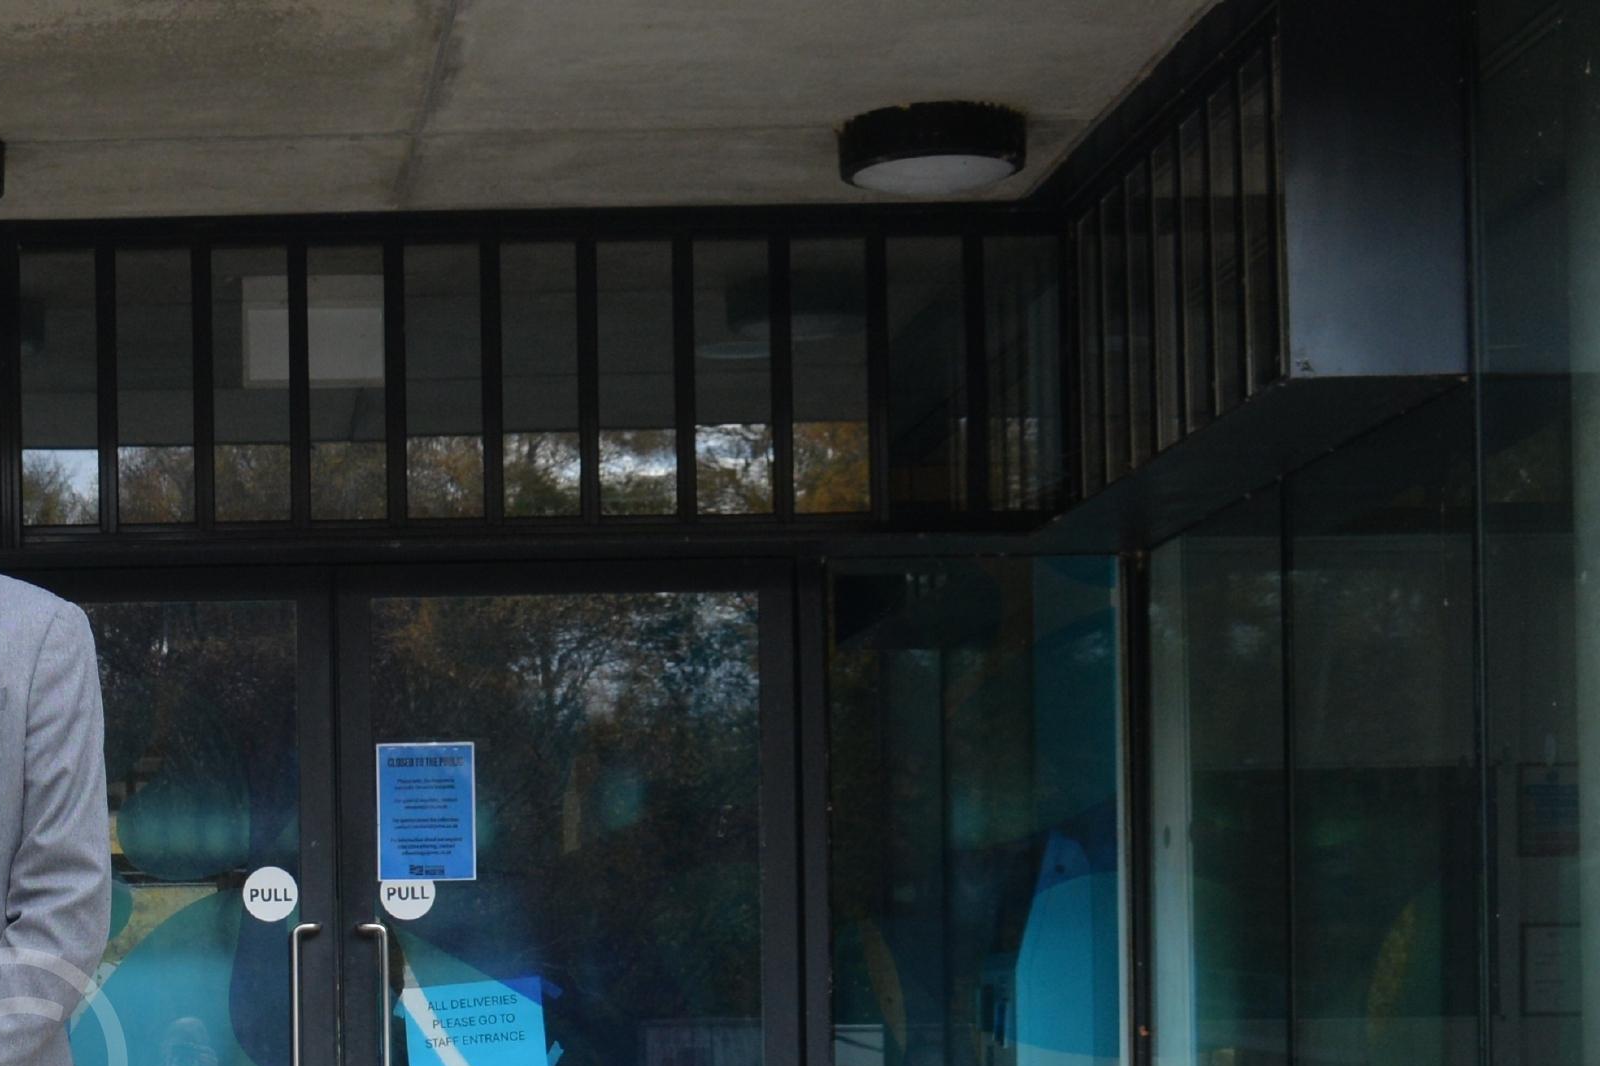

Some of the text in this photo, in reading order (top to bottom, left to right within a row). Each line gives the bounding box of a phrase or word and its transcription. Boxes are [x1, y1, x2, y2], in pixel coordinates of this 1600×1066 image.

[250, 888, 292, 902] PULL
[387, 886, 429, 901] PULL
[428, 994, 518, 1011] ALL DELIVERIES
[432, 1013, 515, 1029] PLEASE GO TO
[425, 1031, 526, 1049] STAFF ENTRANCE
